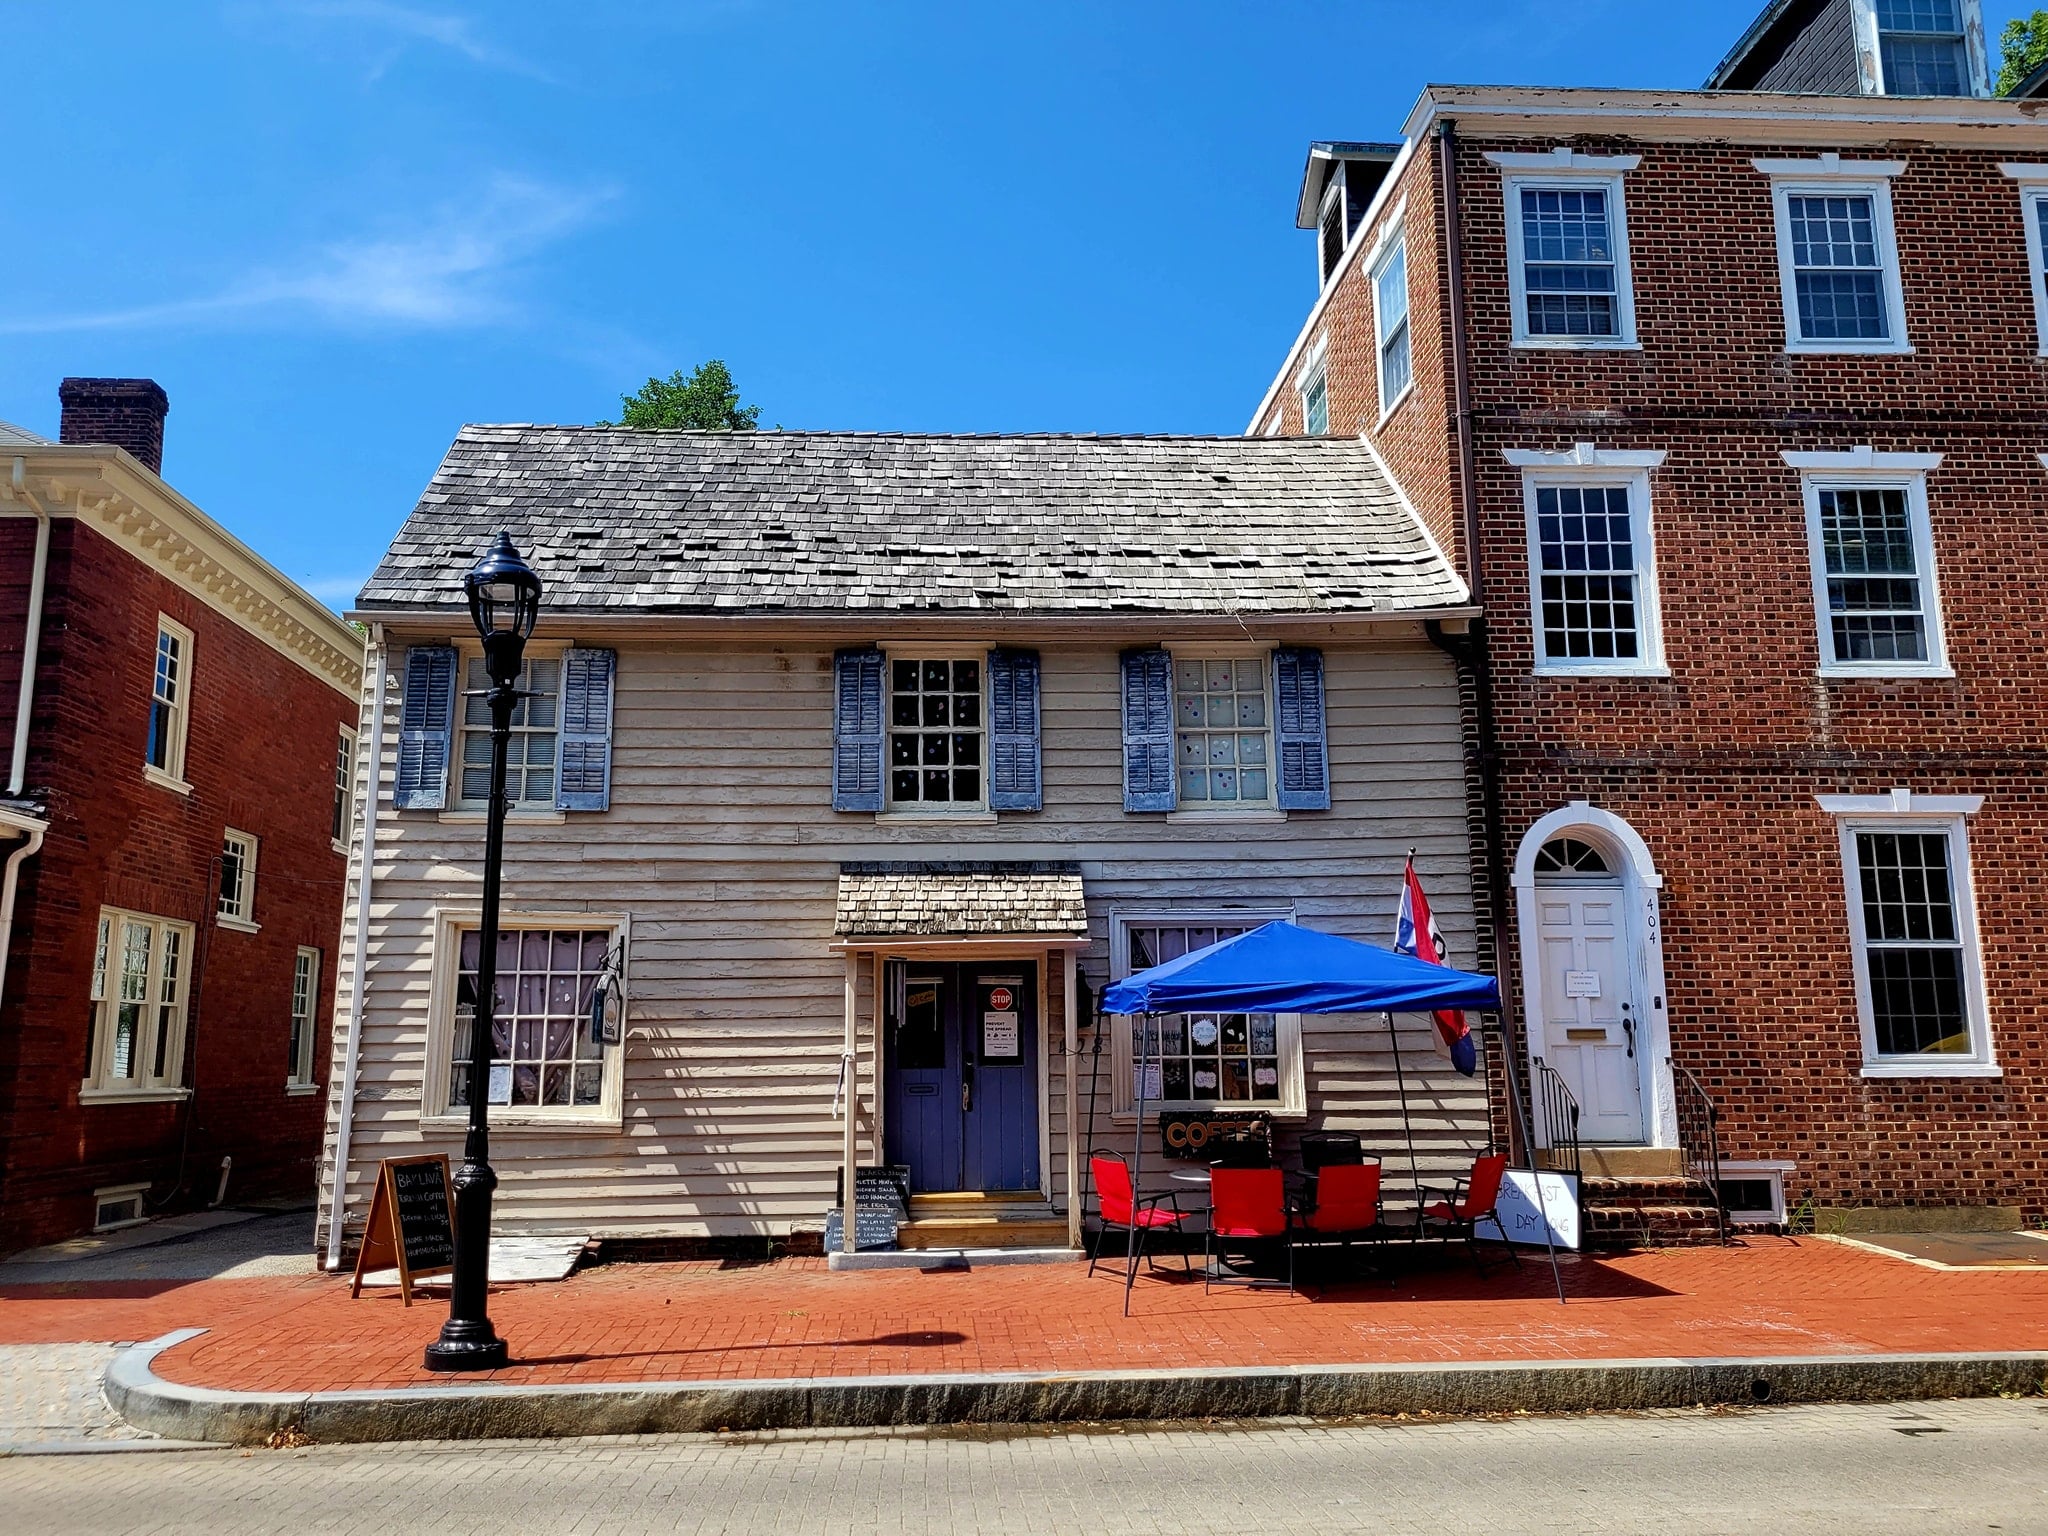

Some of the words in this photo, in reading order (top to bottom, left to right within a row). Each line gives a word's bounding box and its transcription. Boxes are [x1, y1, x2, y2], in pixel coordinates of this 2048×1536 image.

[1647, 898, 1656, 945] 404
[991, 995, 1011, 1004] STOP
[1167, 1120, 1265, 1148] COFFEE
[1515, 1213, 1540, 1231] DAY
